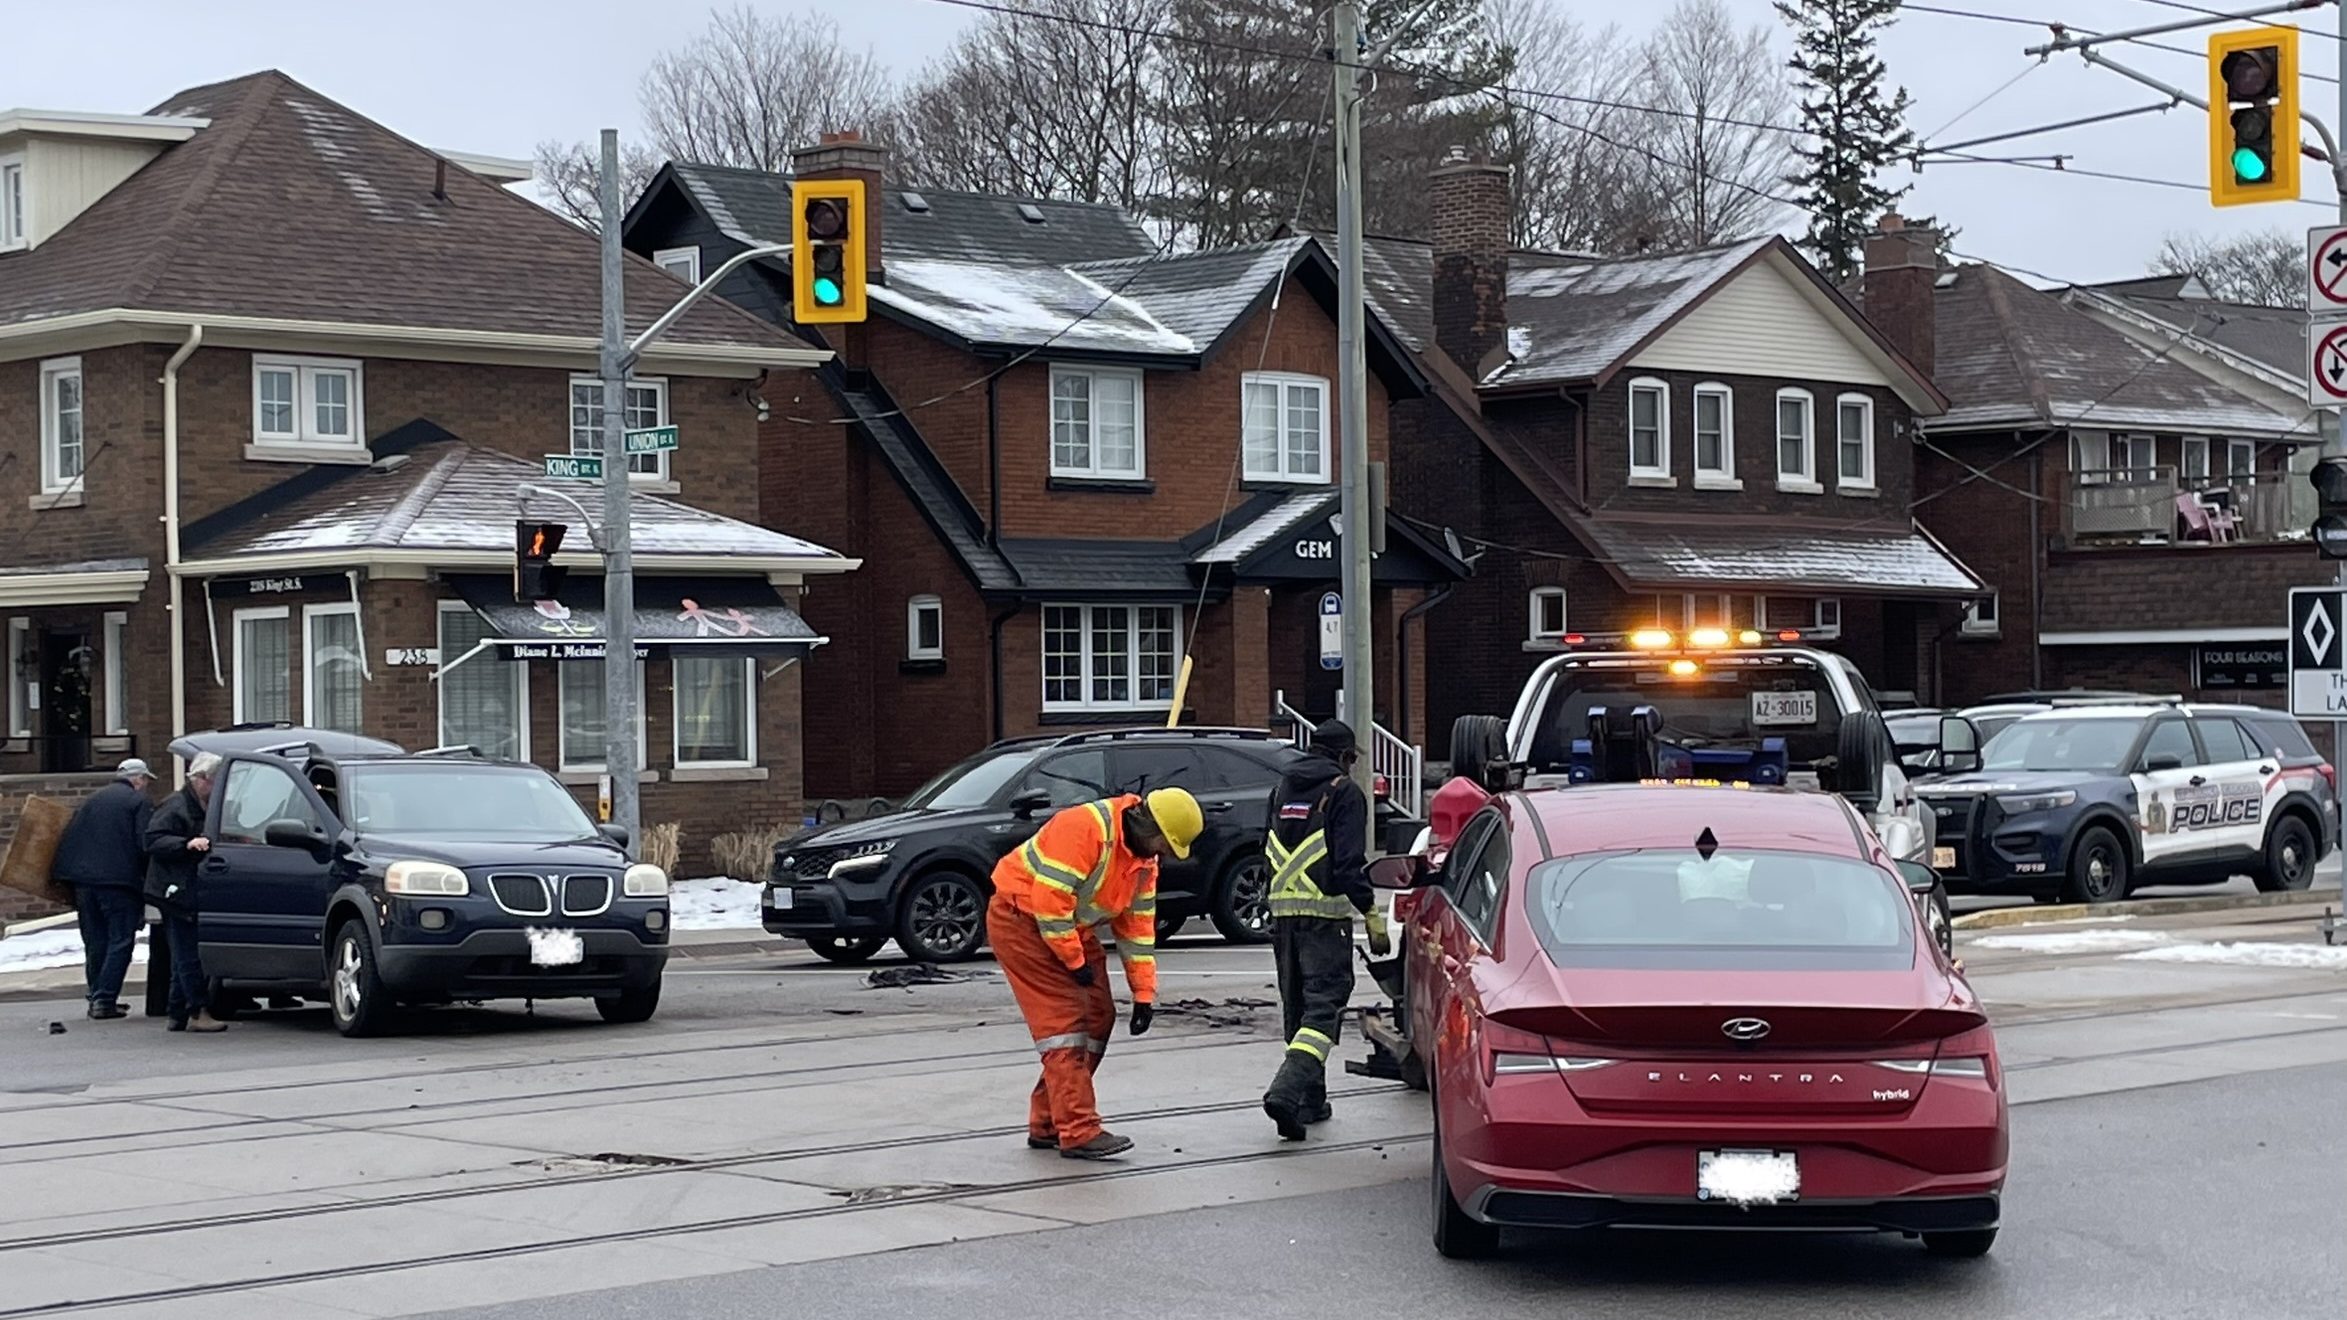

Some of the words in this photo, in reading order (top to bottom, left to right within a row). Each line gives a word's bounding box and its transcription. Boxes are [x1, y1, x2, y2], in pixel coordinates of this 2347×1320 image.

[628, 432, 659, 450] UNION
[546, 458, 579, 476] KING
[1295, 540, 1332, 558] GEM
[400, 649, 428, 665] 238
[513, 644, 548, 658] Diane
[2205, 651, 2234, 664] FOUR
[2235, 650, 2284, 664] SEASONS
[2171, 796, 2261, 831] POLICE
[1648, 1072, 1844, 1083] ELANTRA
[1872, 1089, 1910, 1101] hybrid
